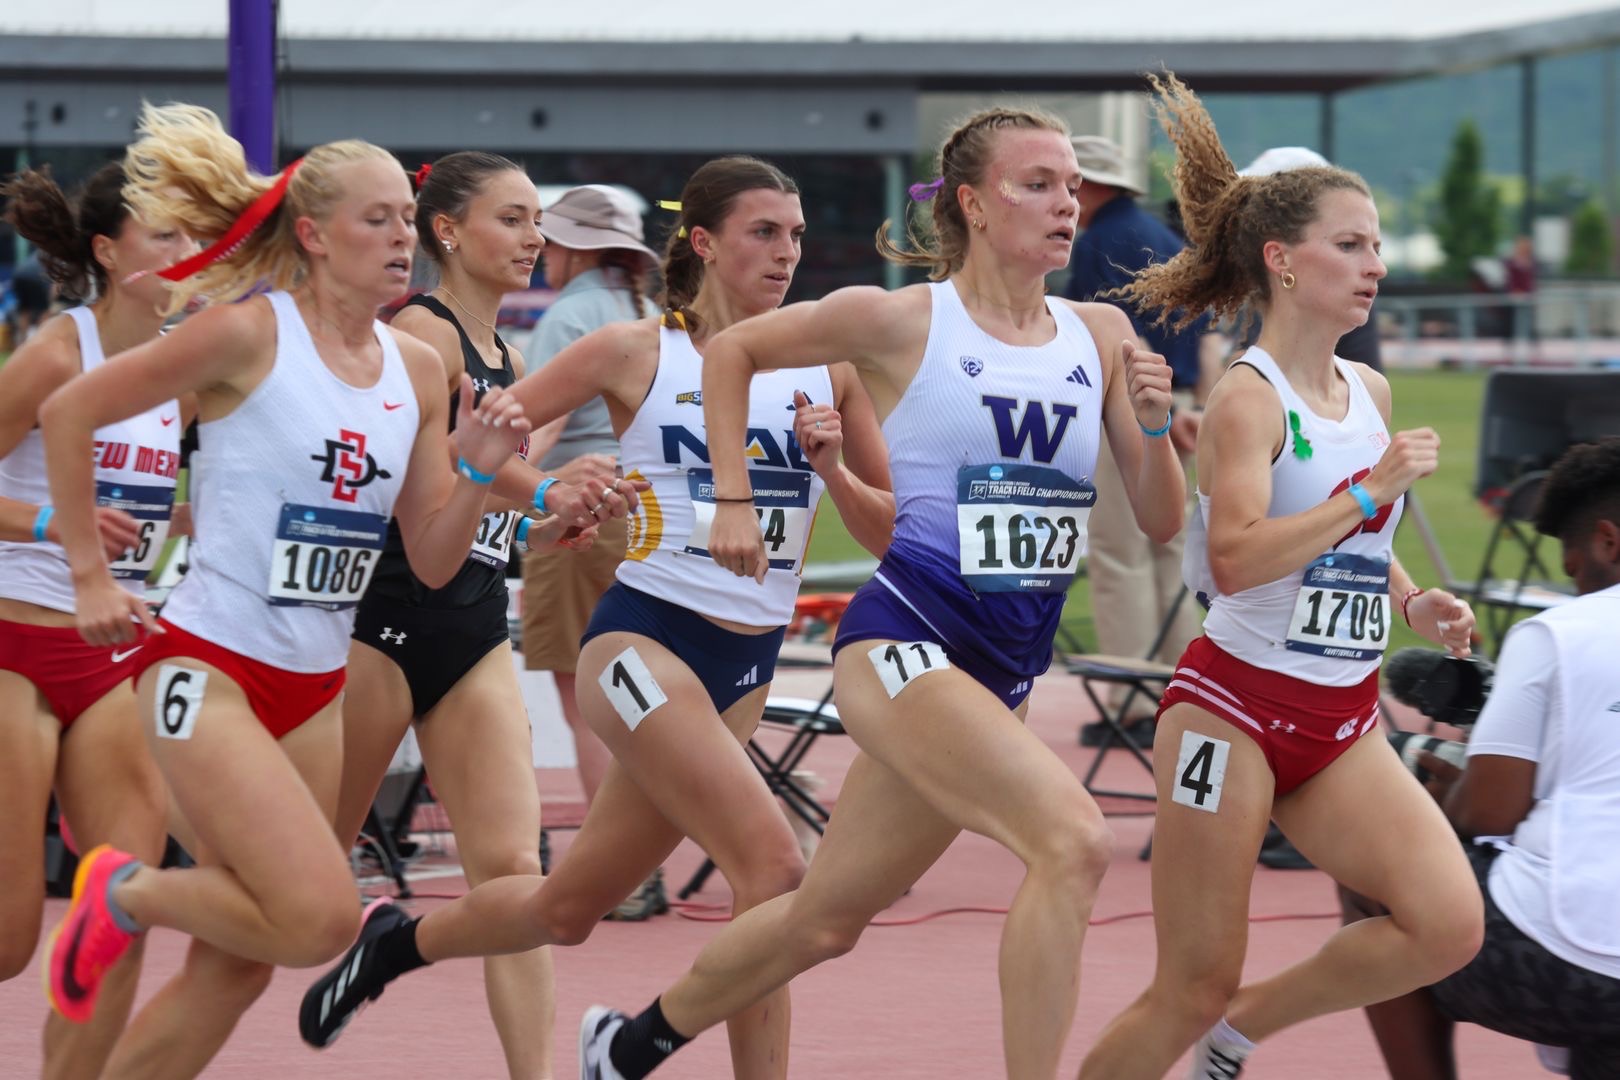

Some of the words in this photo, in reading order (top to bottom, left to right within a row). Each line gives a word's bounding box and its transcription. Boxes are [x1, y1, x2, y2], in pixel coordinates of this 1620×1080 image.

[677, 392, 701, 402] BIGS
[981, 394, 1078, 465] W
[134, 446, 179, 479] MEX
[753, 489, 800, 498] CHAMPIONSHIPS
[988, 485, 1013, 496] TRACK
[1016, 486, 1036, 497] FIELD
[1036, 488, 1094, 501] CHAMPIONSHIPS
[975, 513, 1080, 569] 1623
[282, 543, 372, 595] 1086
[1301, 590, 1385, 642] 1709
[612, 660, 651, 713] 1
[884, 643, 932, 683] 11
[163, 671, 192, 735] 6
[1180, 740, 1216, 806] 4
